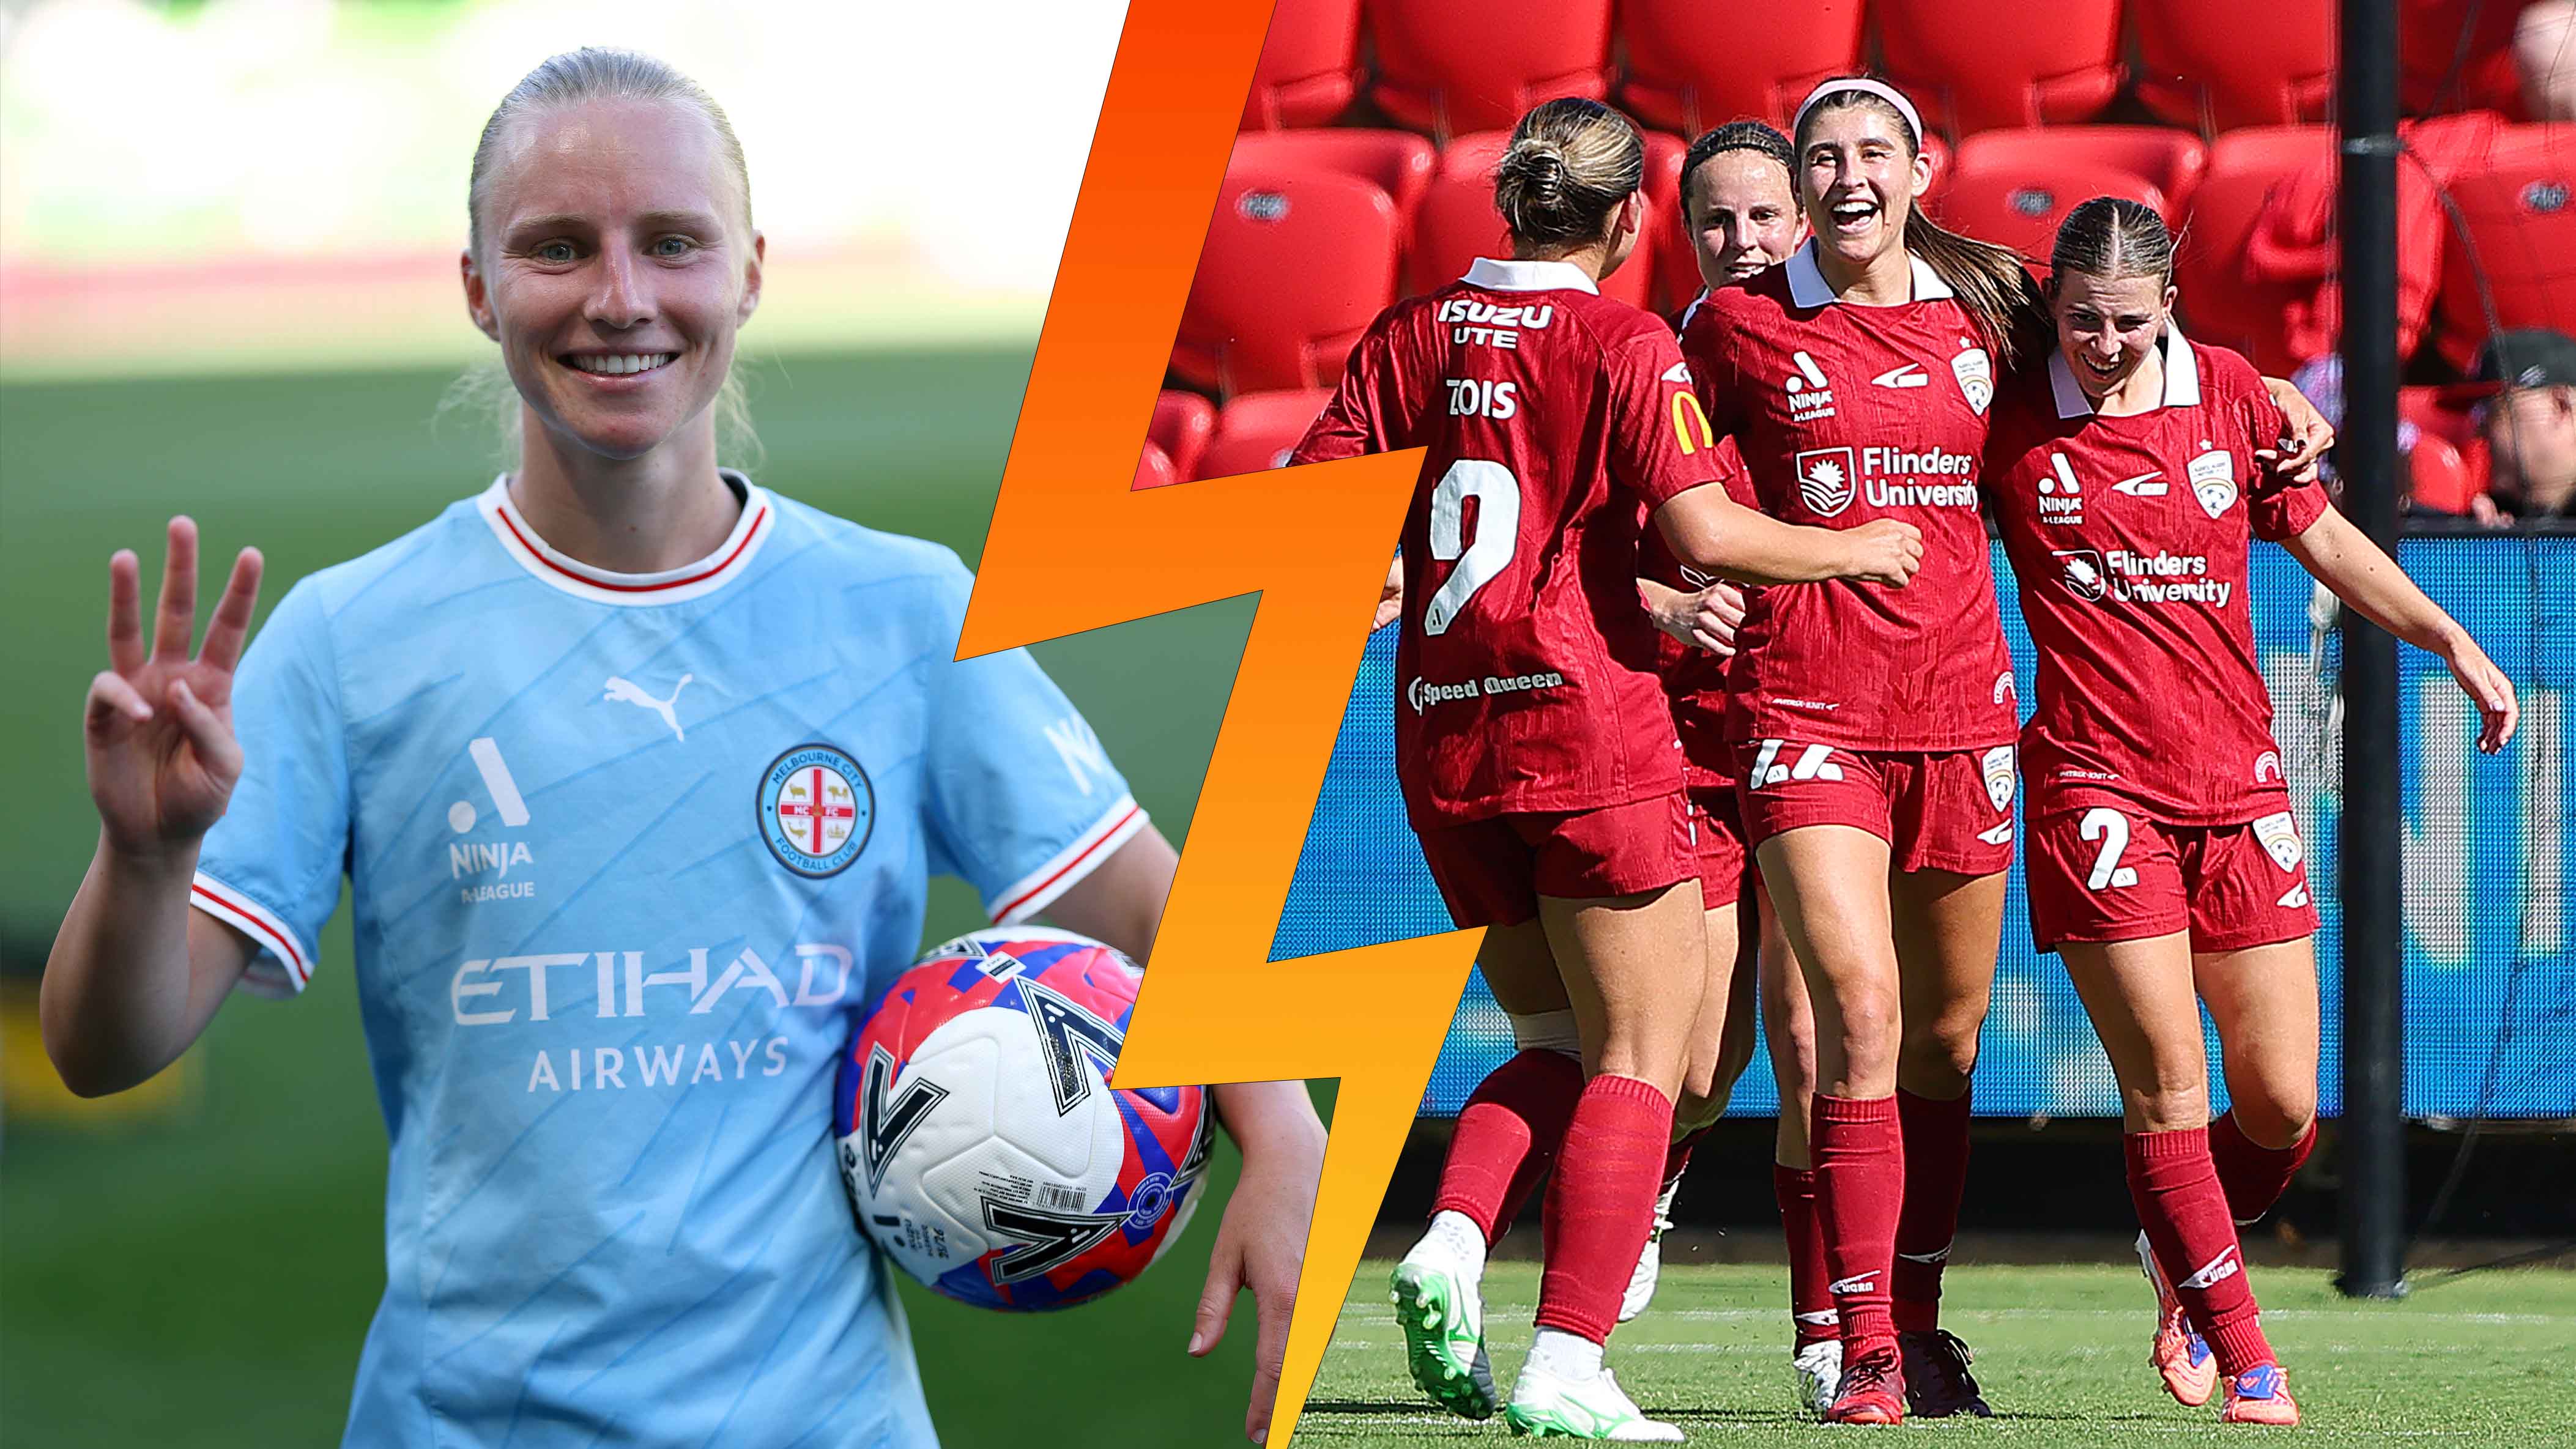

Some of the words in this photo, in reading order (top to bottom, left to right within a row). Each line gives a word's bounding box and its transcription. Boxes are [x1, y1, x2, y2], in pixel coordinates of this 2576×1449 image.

[1438, 299, 1553, 328] ISUZU
[1454, 327, 1518, 349] UTE
[1446, 379, 1516, 419] ZOIS
[1787, 390, 1833, 412] NINJA
[1863, 447, 1972, 475] Flinders
[1865, 479, 1978, 513] University
[2038, 495, 2082, 515] NINJA
[1425, 459, 1521, 636] 9
[2106, 550, 2207, 575] Flinders
[1423, 680, 1479, 705] Speed
[1484, 673, 1563, 694] Queen
[773, 752, 841, 785] MELBOURNE
[841, 763, 864, 788] CITY
[449, 842, 534, 880] NINJA
[775, 837, 830, 870] FOOTBALL
[832, 841, 857, 867] CLUB
[2080, 808, 2138, 891] 2
[451, 944, 853, 1025] ETIHAD
[527, 1036, 789, 1092] AIRWAYS
